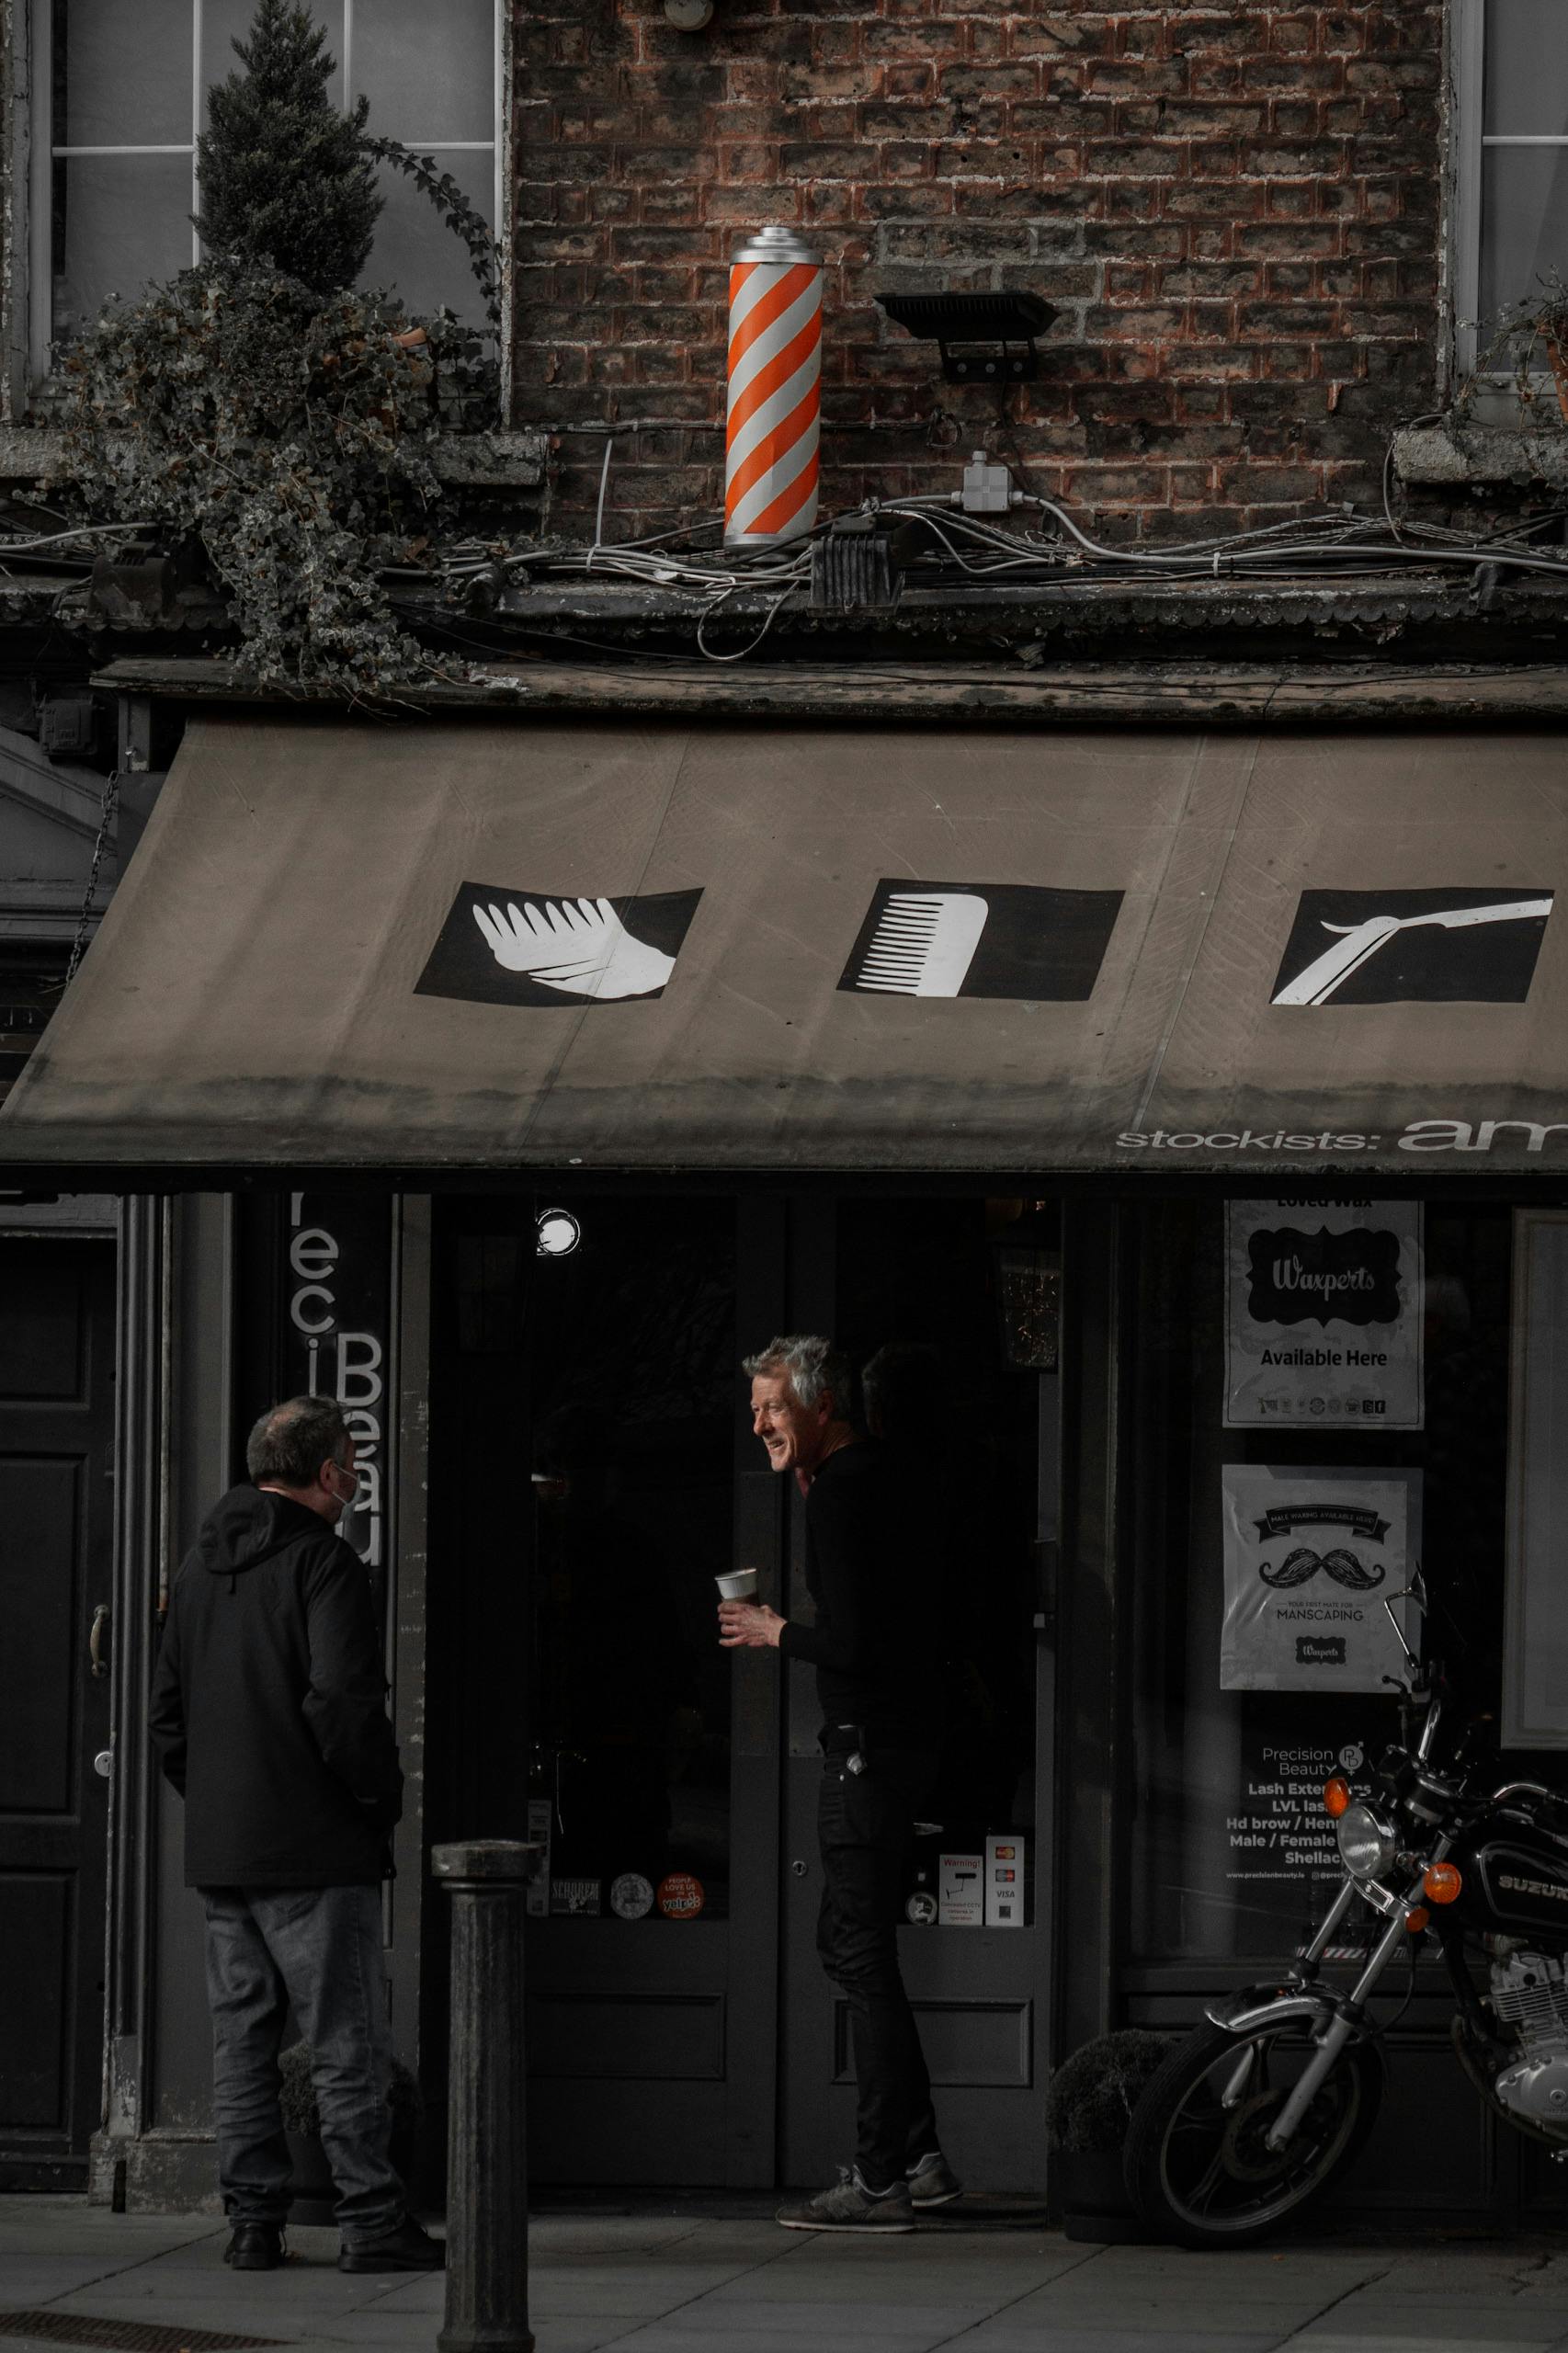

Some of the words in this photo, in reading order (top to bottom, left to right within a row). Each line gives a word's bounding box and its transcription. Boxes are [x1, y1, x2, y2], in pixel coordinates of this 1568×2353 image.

[1115, 1130, 1381, 1151] stockists:
[1272, 1254, 1375, 1302] Waxperts
[1261, 1349, 1342, 1366] Available
[1346, 1350, 1388, 1366] Here
[1277, 1609, 1364, 1621] MANSCAPING
[1262, 1746, 1334, 1761] Precision
[1278, 1762, 1338, 1777] Beauty
[1248, 1782, 1285, 1796] Lash
[1272, 1800, 1301, 1813] LVL
[1303, 1800, 1329, 1813] las
[1226, 1816, 1248, 1830] Hd
[1252, 1816, 1291, 1830] brow
[1230, 1833, 1267, 1847] Male
[1279, 1833, 1336, 1847] Female
[943, 1859, 981, 1869] Warning!
[1284, 1850, 1341, 1865] Shellac
[996, 1890, 1016, 1898] VISA
